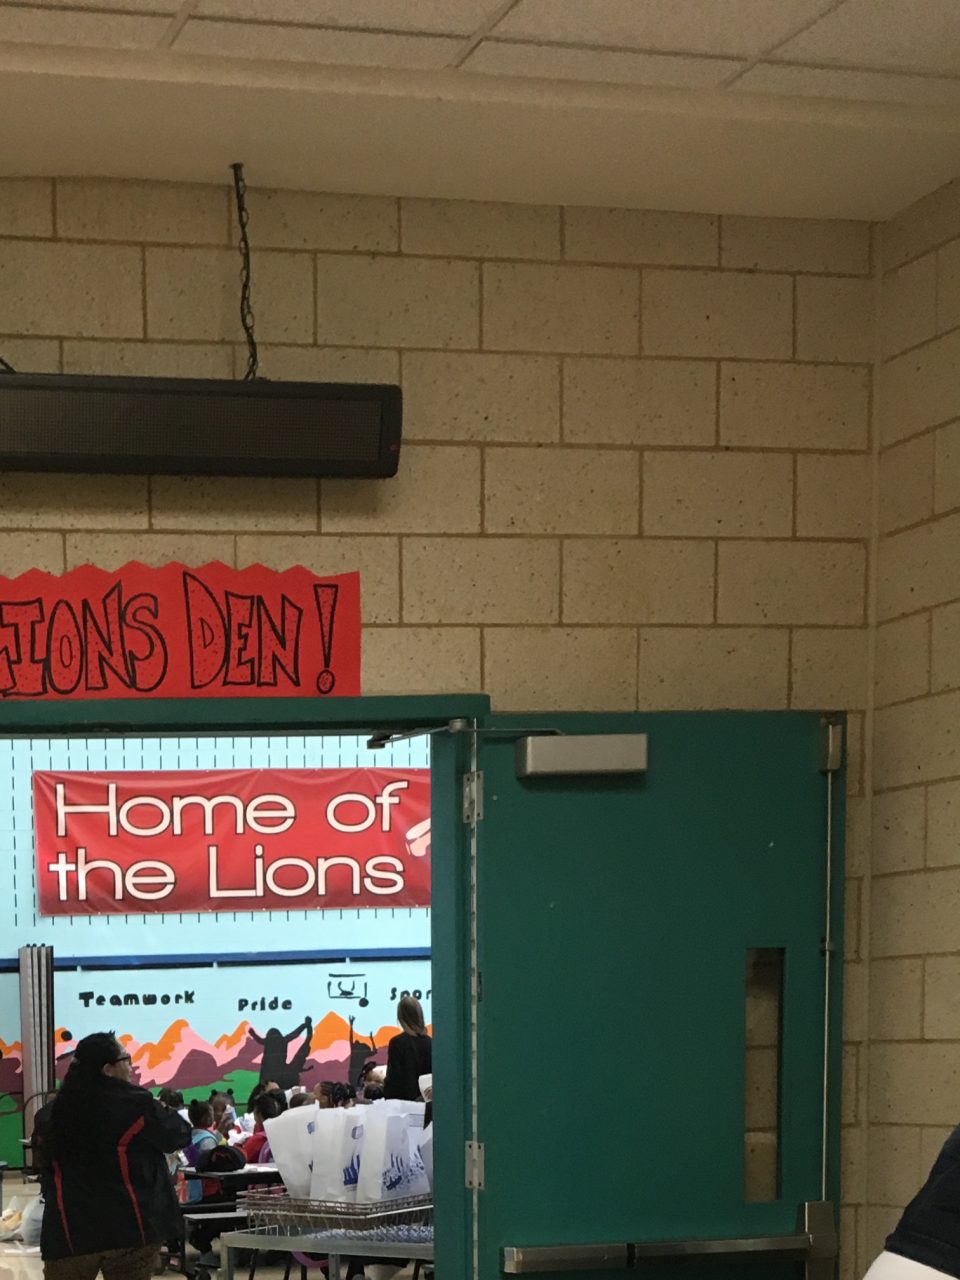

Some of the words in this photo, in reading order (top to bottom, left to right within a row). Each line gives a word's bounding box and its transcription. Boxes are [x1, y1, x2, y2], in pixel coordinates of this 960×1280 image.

[55, 782, 296, 838] Home
[326, 780, 411, 834] of
[48, 850, 177, 902] the
[208, 844, 406, 899] Lions
[238, 997, 293, 1011] Pride
